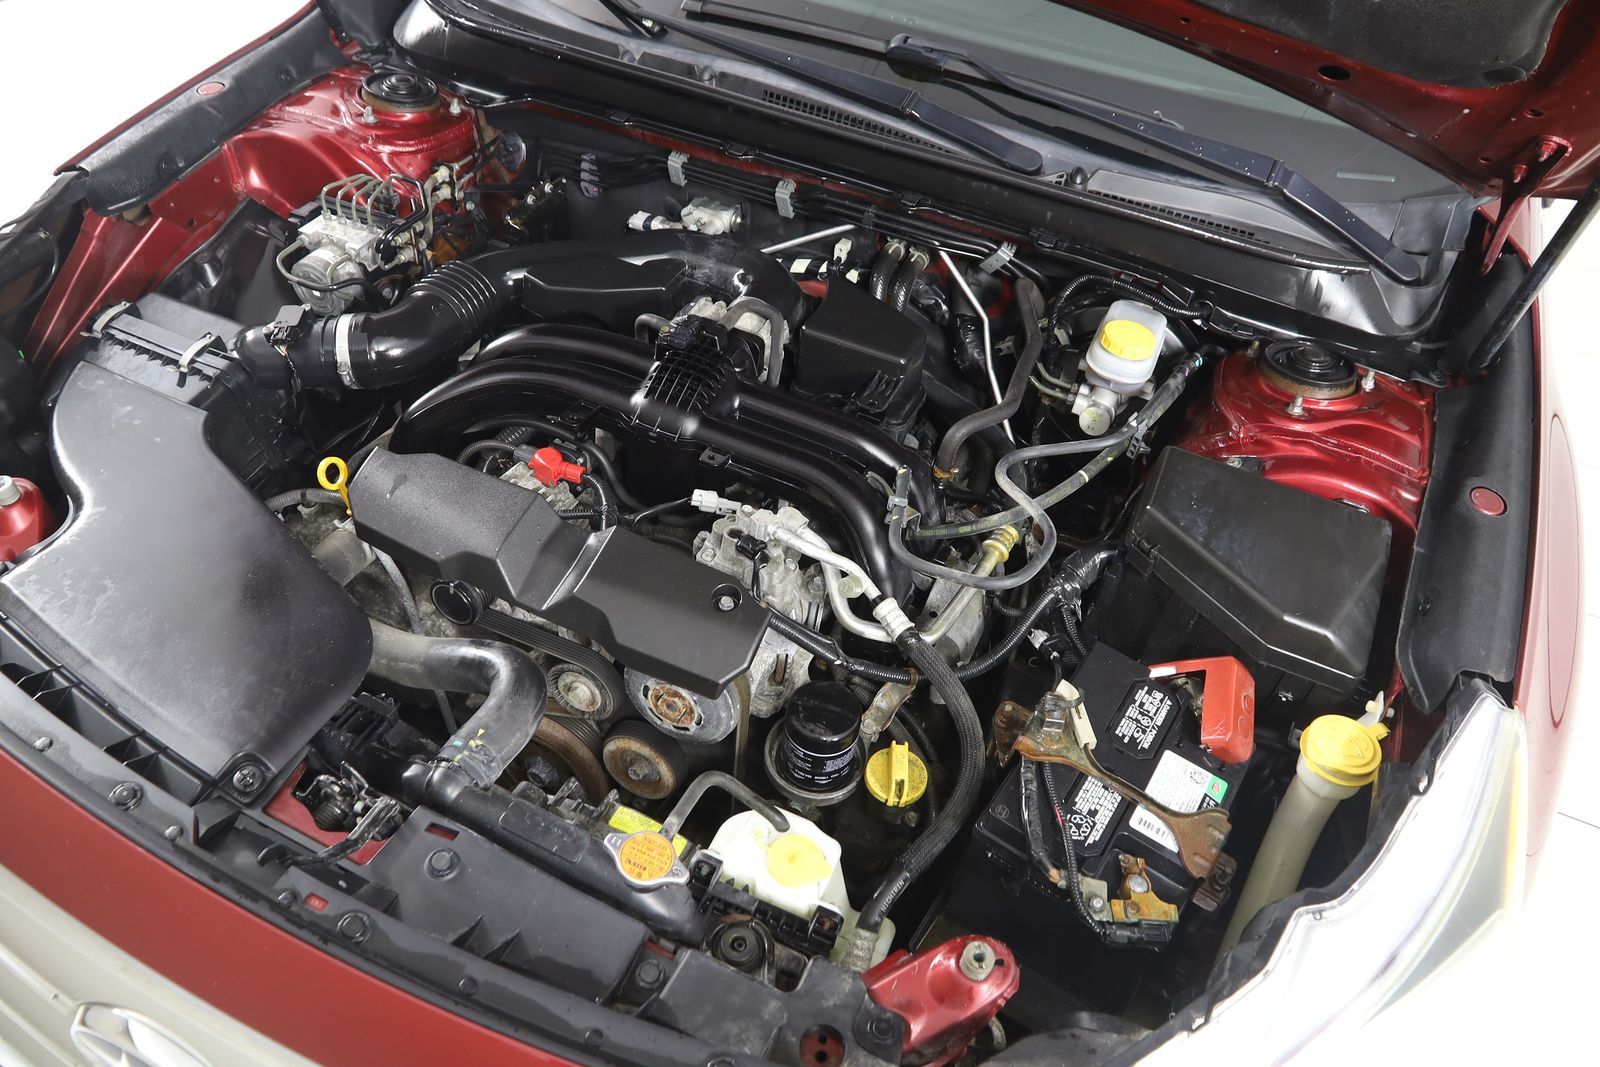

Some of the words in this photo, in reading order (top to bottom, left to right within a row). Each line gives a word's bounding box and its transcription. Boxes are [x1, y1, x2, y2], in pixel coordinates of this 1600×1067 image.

[1154, 703, 1171, 726] DANGER
[1141, 727, 1157, 749] POISON
[880, 879, 905, 912] NICHIRIN
